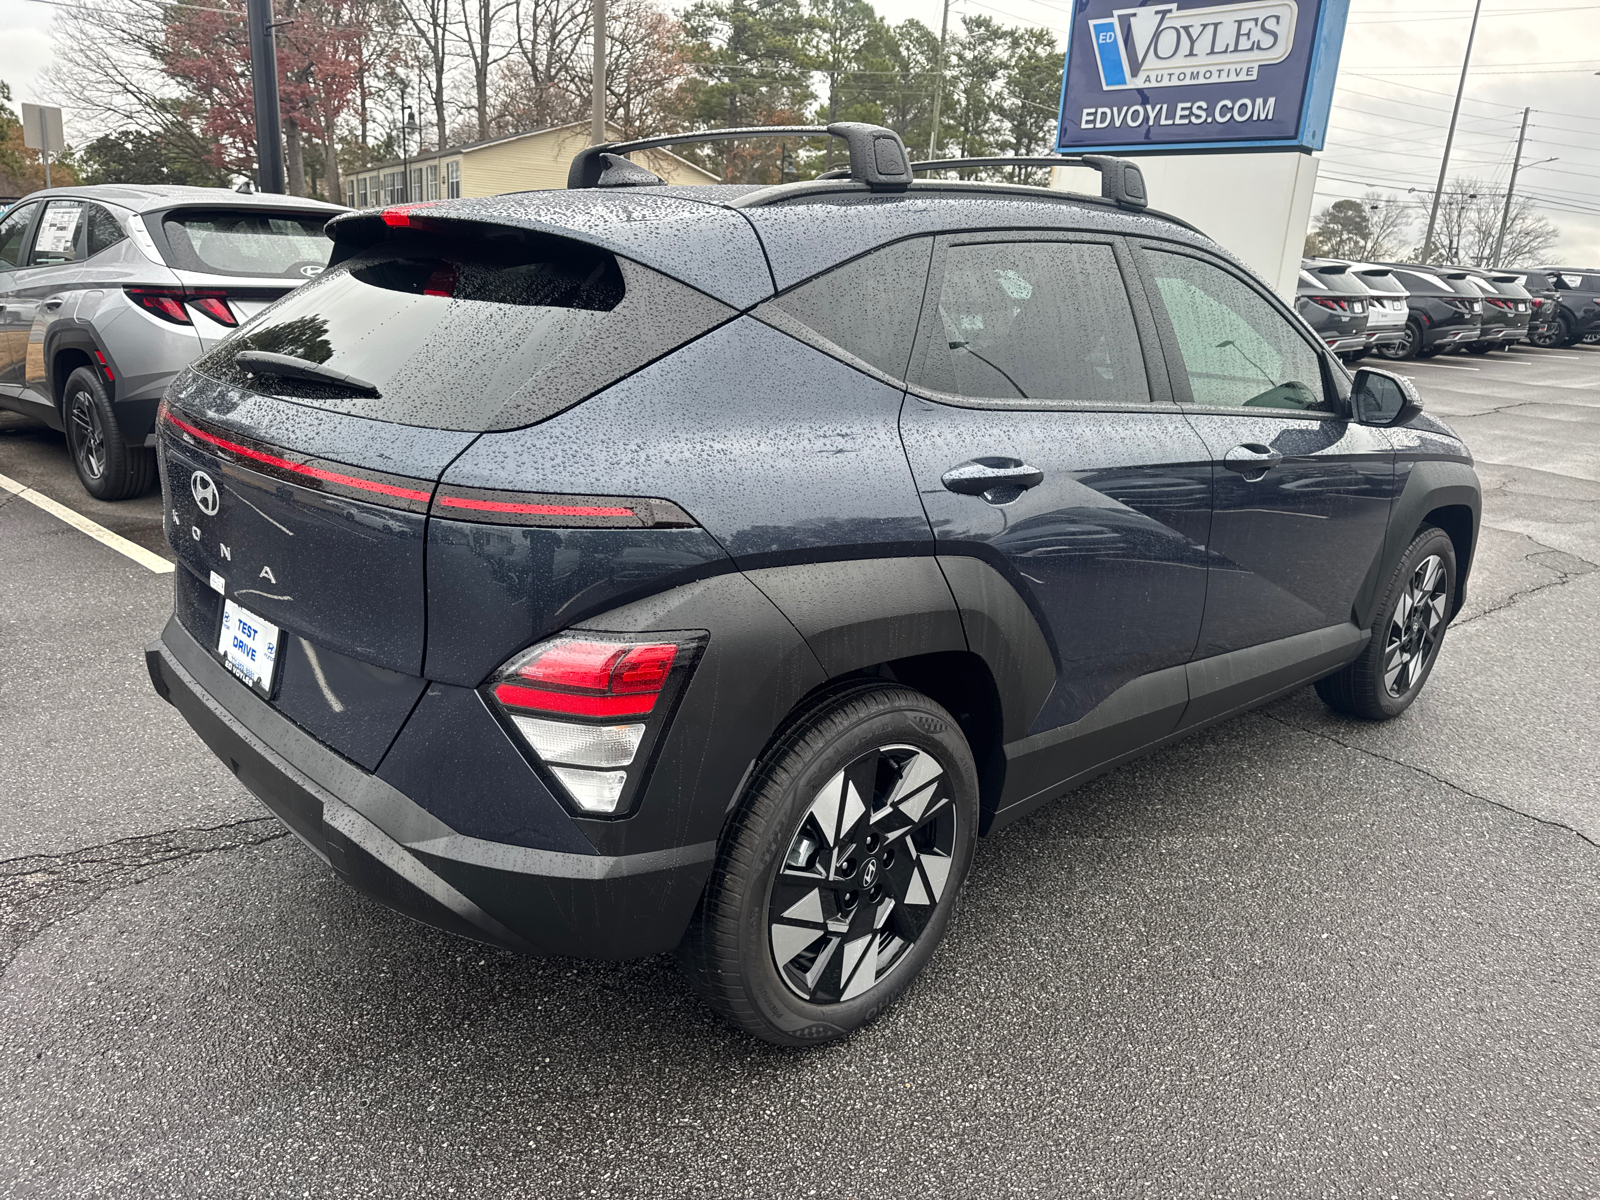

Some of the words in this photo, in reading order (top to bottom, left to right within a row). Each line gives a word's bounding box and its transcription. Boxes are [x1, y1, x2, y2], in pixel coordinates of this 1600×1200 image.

[1098, 32, 1115, 44] ED
[1117, 8, 1281, 78] VOYLES
[1143, 66, 1255, 84] AUTOMOTIVE
[1080, 97, 1276, 129] EDVOYLES.COM
[238, 619, 258, 641] TEST
[233, 635, 257, 662] DRIVE
